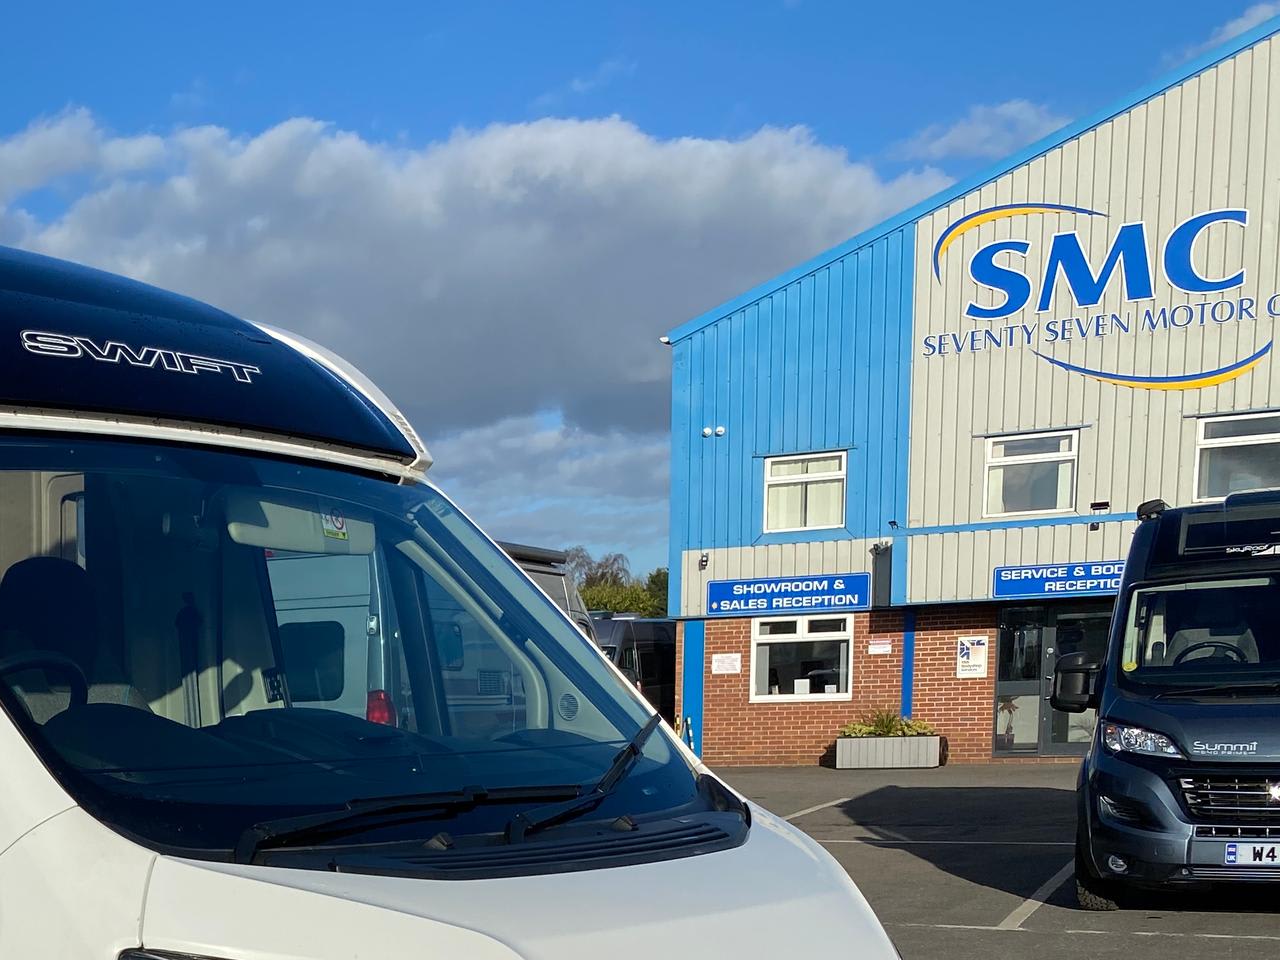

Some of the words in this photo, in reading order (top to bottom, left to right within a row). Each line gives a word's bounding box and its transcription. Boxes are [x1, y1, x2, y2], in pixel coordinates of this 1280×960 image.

[965, 208, 1249, 320] SMC
[922, 322, 1037, 357] SEVENTY
[1045, 311, 1131, 344] SEVEN
[1141, 297, 1255, 331] MOTOR
[20, 330, 262, 383] SWIFT
[1001, 567, 1067, 580] SERVICE
[1073, 566, 1085, 577] &
[733, 580, 828, 595] SHOWROOM
[833, 579, 845, 590] &
[720, 599, 767, 611] SALES
[773, 594, 858, 608] RECEPTION
[1193, 740, 1258, 751] Summit
